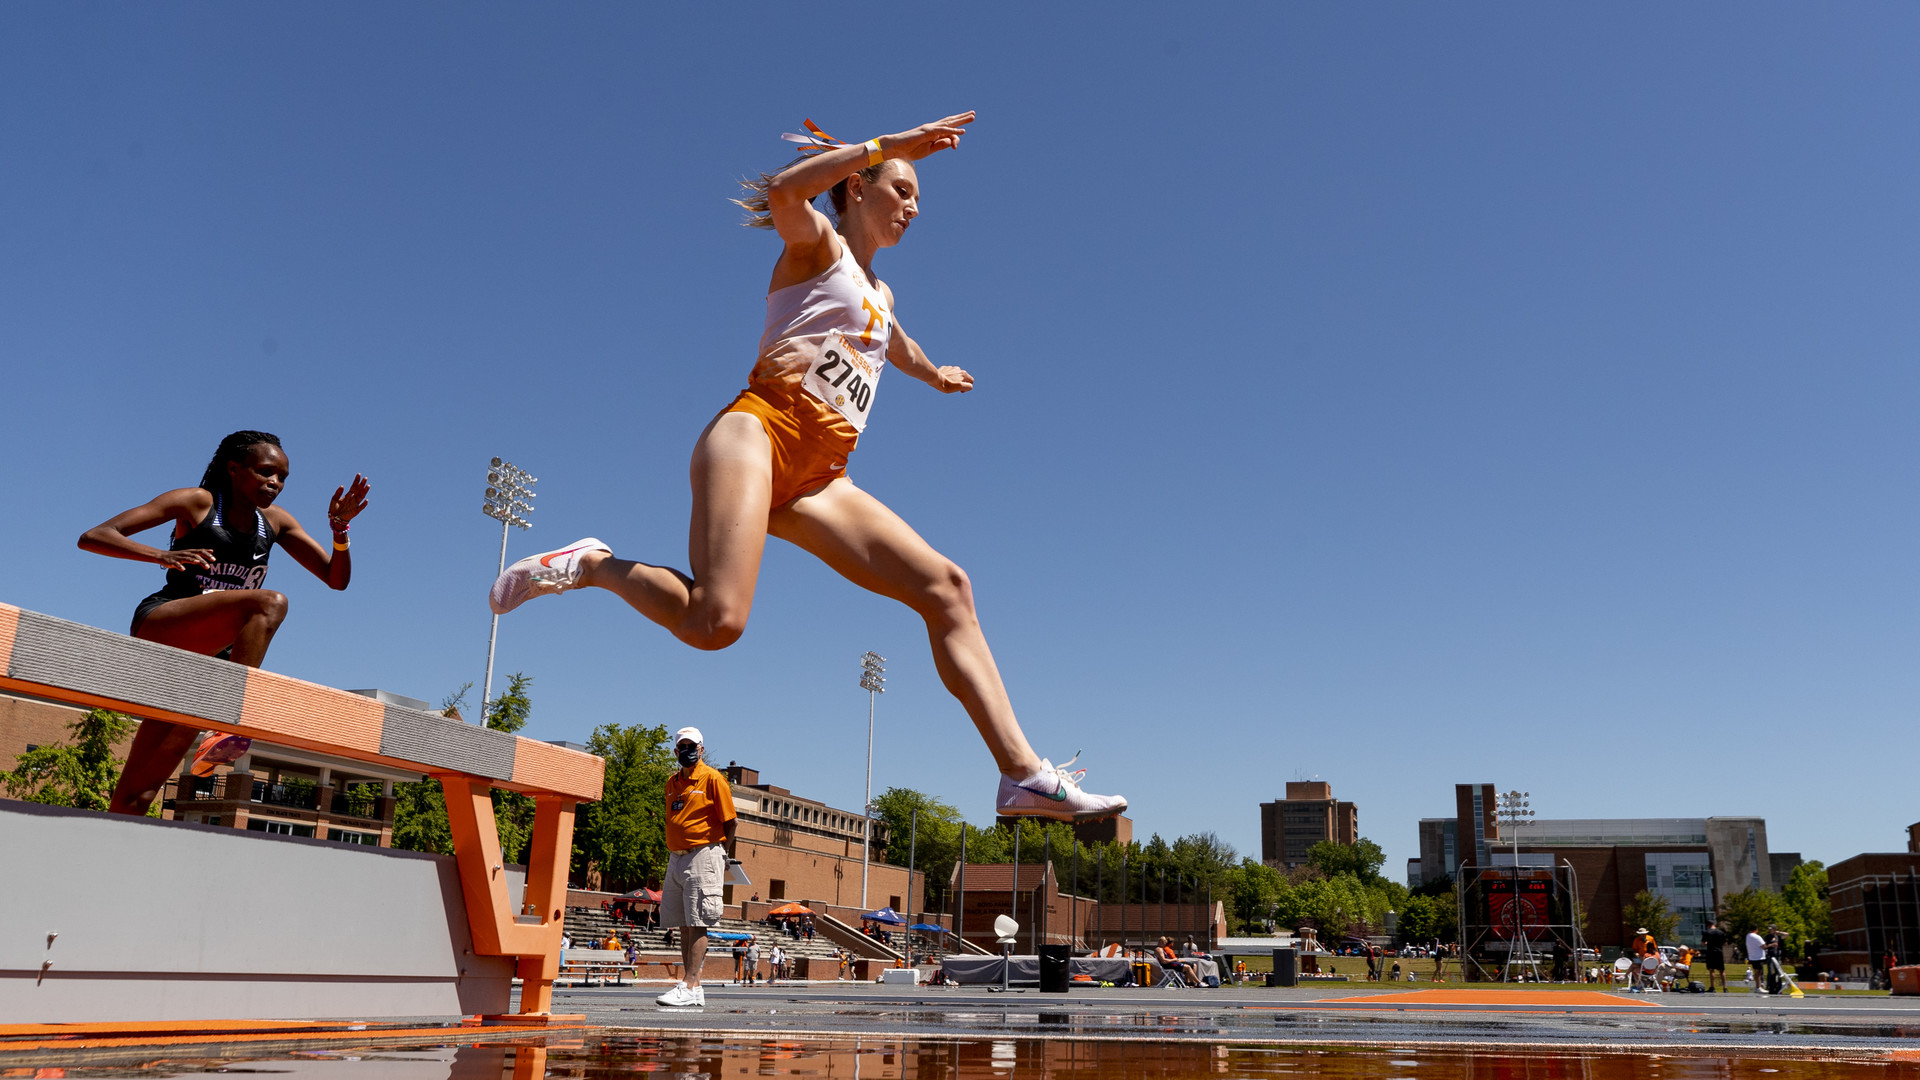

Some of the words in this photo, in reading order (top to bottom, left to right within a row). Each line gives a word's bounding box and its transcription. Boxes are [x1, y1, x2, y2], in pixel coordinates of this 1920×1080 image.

[839, 334, 873, 378] TENNESSEE
[815, 349, 871, 413] 2740
[209, 563, 250, 579] MIDDL
